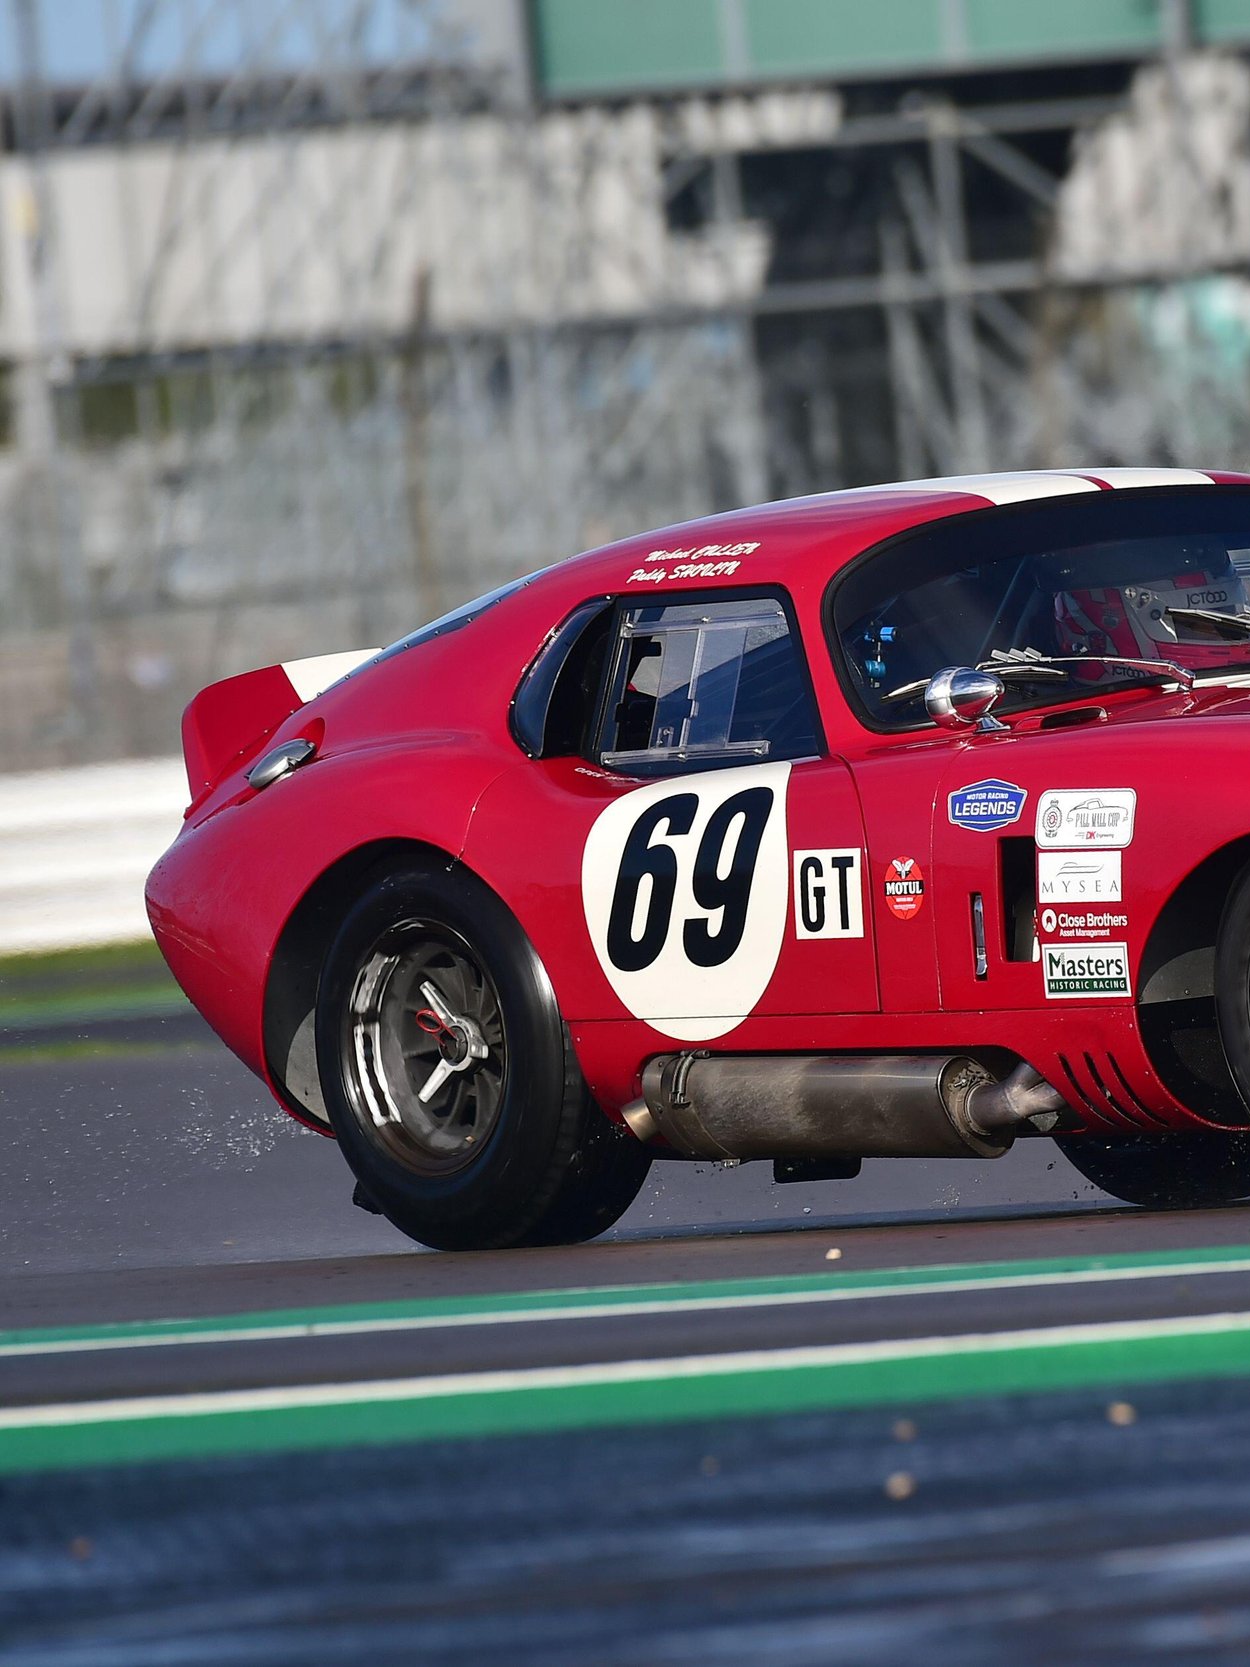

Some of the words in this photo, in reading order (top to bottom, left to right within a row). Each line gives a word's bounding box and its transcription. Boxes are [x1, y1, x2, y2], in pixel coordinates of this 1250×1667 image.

[626, 568, 667, 584] Paddy
[987, 792, 1009, 800] RACING
[954, 801, 1017, 816] LEGENDS
[606, 786, 774, 972] 69
[800, 855, 854, 932] GT
[886, 881, 922, 895] MOTUL
[1041, 880, 1119, 894] MYSEA
[1058, 913, 1086, 927] Close
[1086, 912, 1128, 927] Brothers
[1059, 928, 1075, 937] Asset
[1075, 928, 1111, 938] Management
[1048, 952, 1124, 977] Masters
[1050, 981, 1090, 990] HISTORIC
[1093, 980, 1125, 989] RACING
